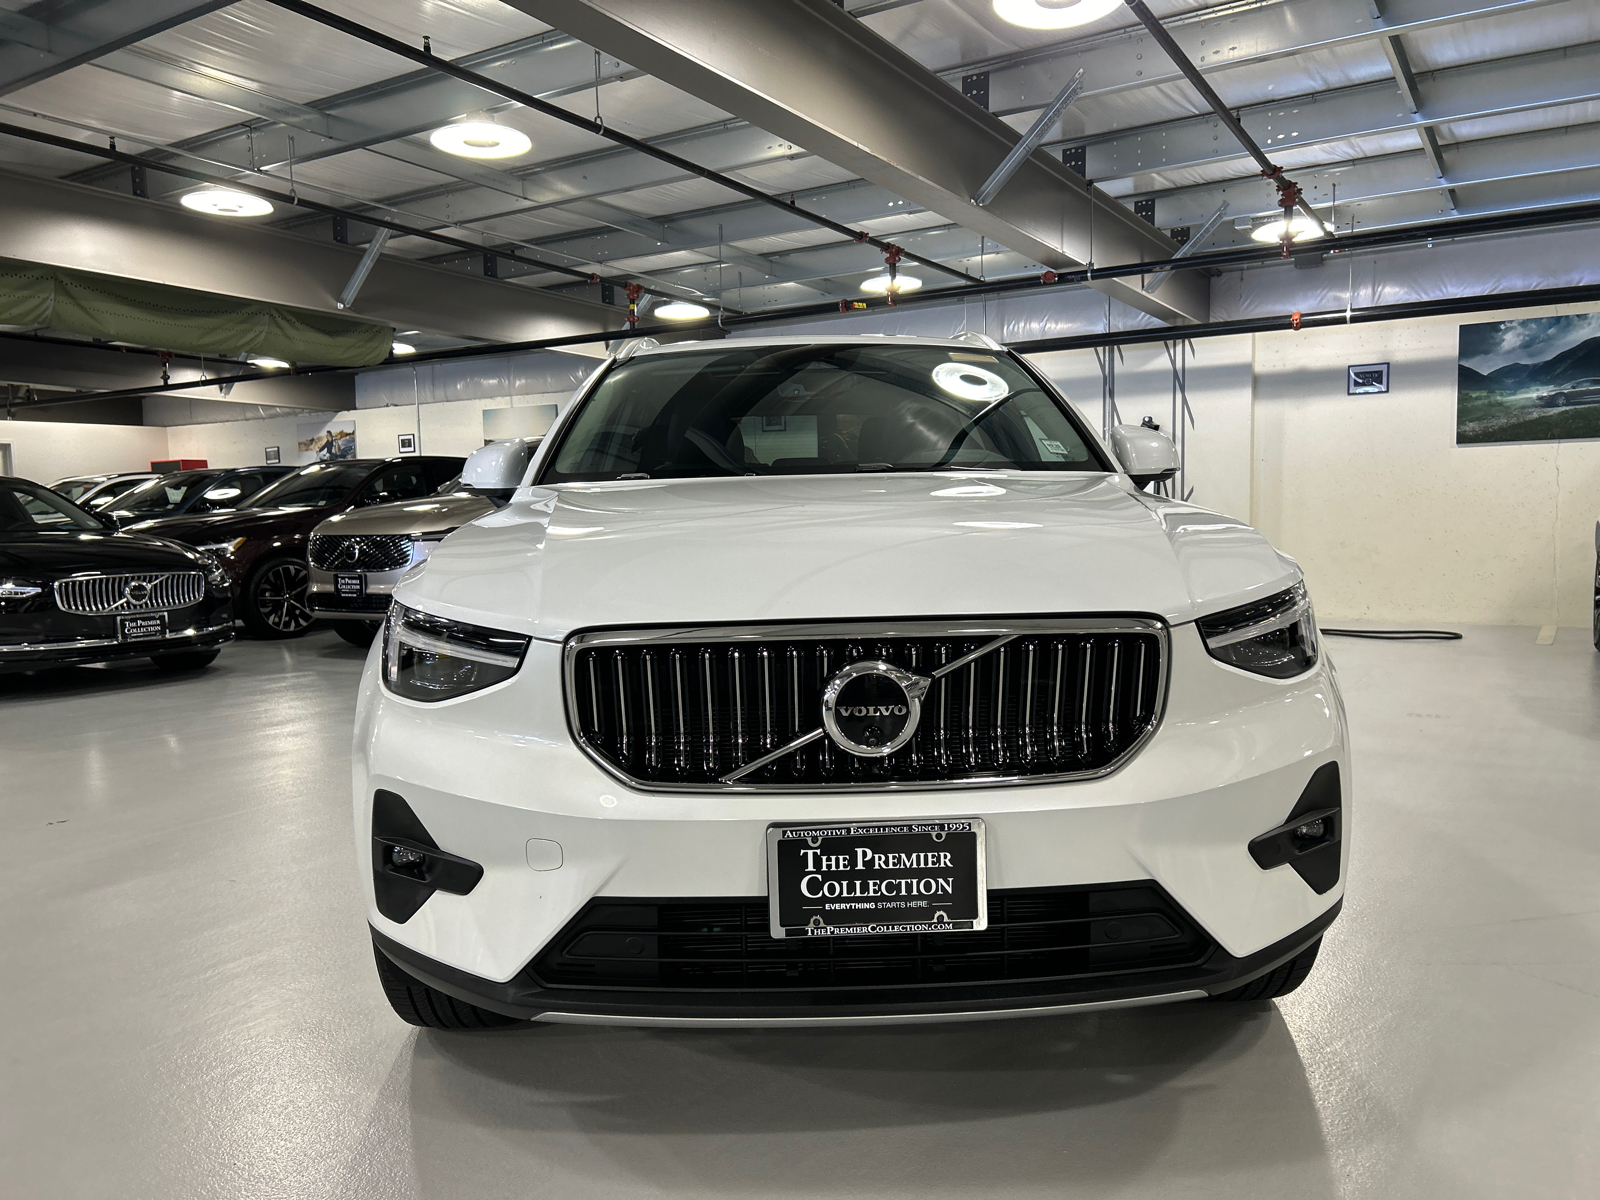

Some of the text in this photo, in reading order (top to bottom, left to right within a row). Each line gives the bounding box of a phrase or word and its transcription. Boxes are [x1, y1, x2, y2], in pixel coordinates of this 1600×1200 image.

[836, 705, 907, 717] VOLVO
[944, 822, 970, 831] 1995
[800, 847, 953, 872] THE PREMIER
[800, 874, 954, 899] COLLECTION
[825, 900, 930, 911] EVERYTHING STARTS HERE.
